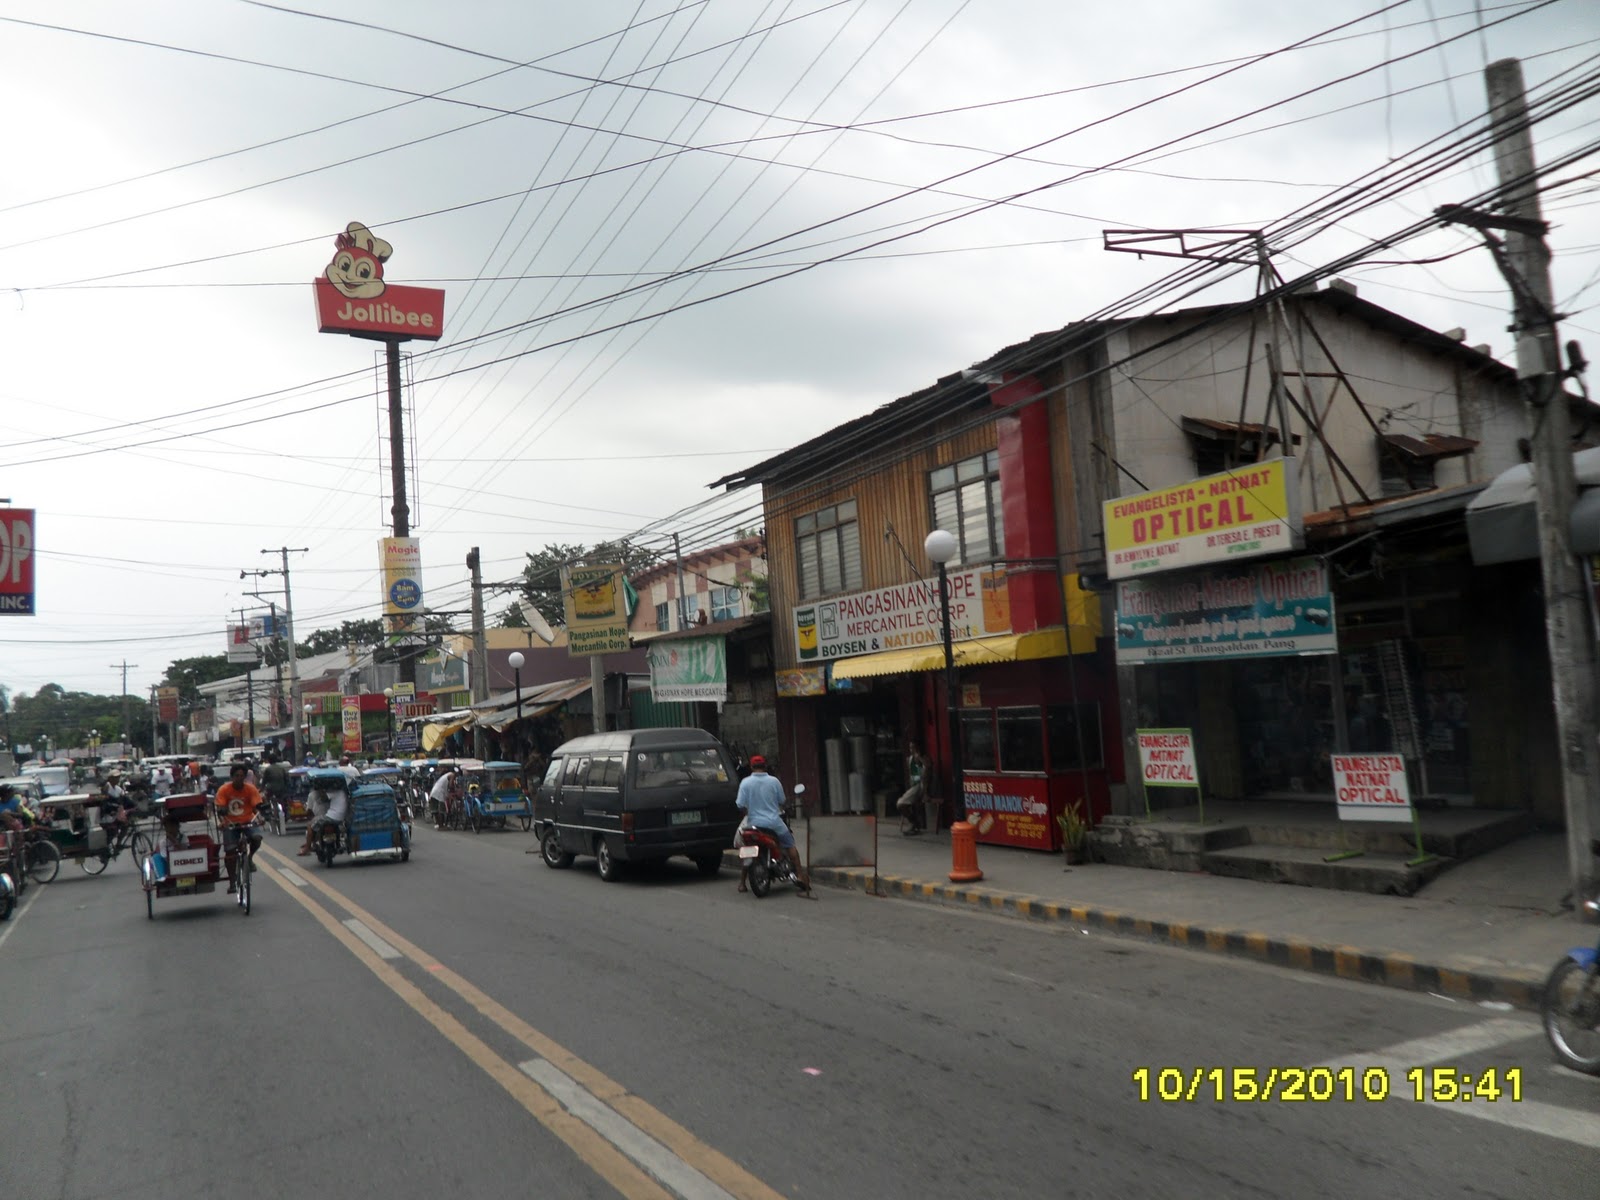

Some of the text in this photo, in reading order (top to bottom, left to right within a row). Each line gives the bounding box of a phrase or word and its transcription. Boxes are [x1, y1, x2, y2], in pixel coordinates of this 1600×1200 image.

[337, 301, 434, 328] Jollibee
[1113, 488, 1196, 519] EVANGELISTA
[1209, 469, 1271, 497] NATNAT
[1132, 495, 1254, 544] OPTICAL
[387, 545, 419, 556] Magic
[1260, 565, 1327, 611] Optical
[838, 584, 928, 621] PANGASINAN
[846, 612, 925, 638] MERCANTILE
[569, 627, 626, 641] Pangasinan Hope
[571, 640, 627, 653] Mercantile Corp.
[821, 639, 867, 658] BOYSEN
[871, 638, 880, 650] &
[883, 629, 935, 648] NATION
[405, 704, 433, 717] LOTTO
[1140, 735, 1190, 748] EVANGELISTA
[1149, 750, 1185, 762] NATNAT
[1334, 756, 1405, 772] EVANGELISTA
[1145, 764, 1194, 781] OPTICAL
[1345, 772, 1391, 787] NATNAT
[964, 792, 994, 811] ECHON
[994, 795, 1024, 813] MANOK
[1338, 787, 1405, 804] OPTICAL
[173, 857, 204, 867] ROMEO
